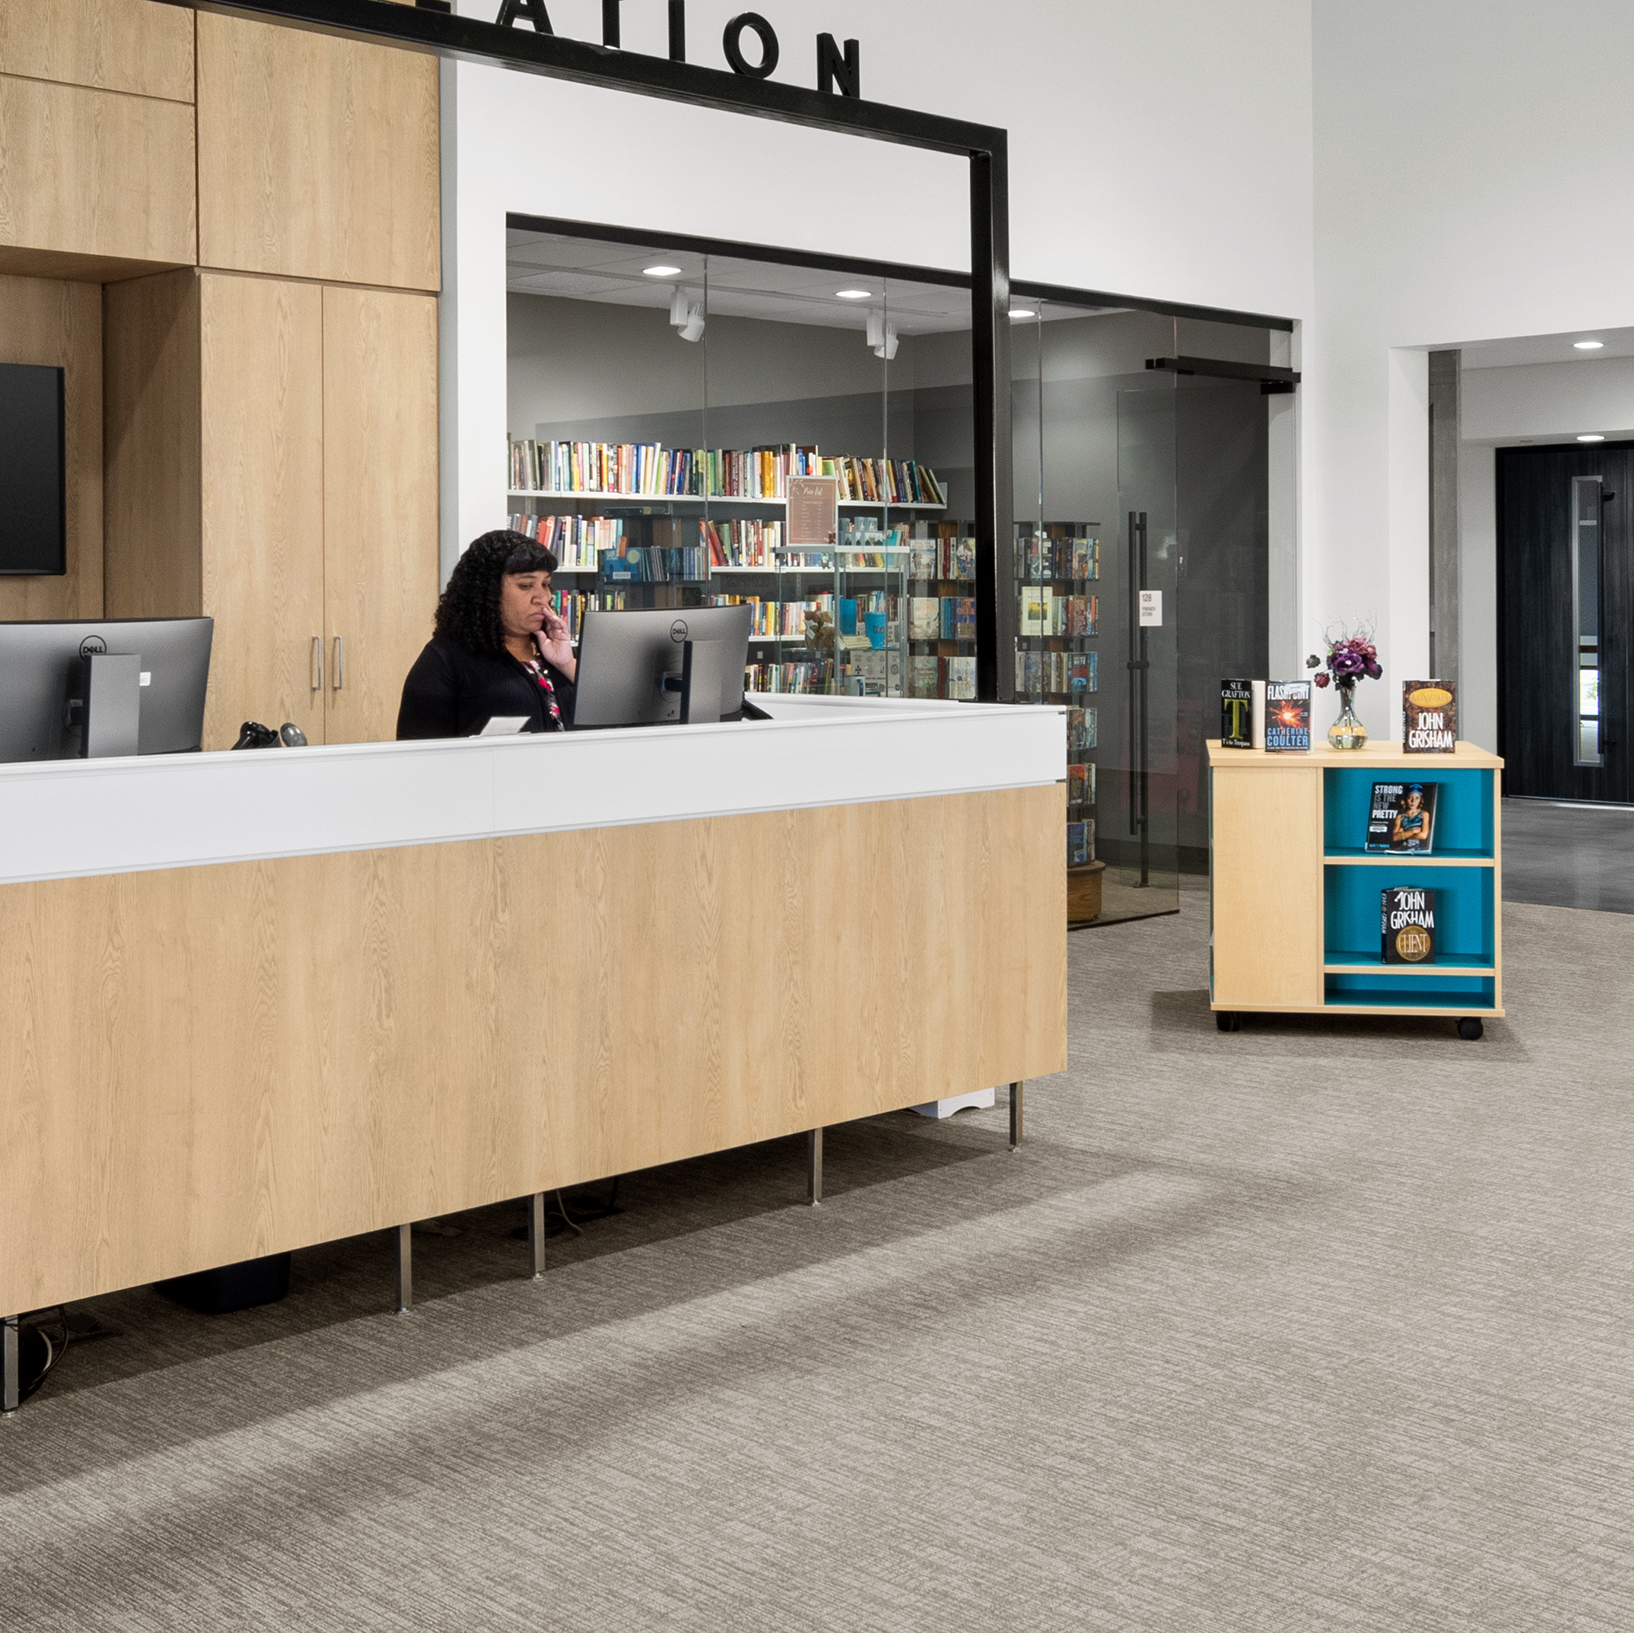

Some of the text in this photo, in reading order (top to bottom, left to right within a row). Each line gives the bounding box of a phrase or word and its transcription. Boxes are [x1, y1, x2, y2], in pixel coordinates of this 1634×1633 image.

[1142, 593, 1152, 602] 128
[83, 646, 103, 654] DELL
[1230, 682, 1242, 690] SUE
[1221, 689, 1250, 698] GRAFTON
[1224, 698, 1248, 739] T
[1417, 712, 1443, 730] JOHN
[1267, 736, 1308, 746] COULTER
[1409, 730, 1453, 748] GRISHAM
[1374, 785, 1403, 794] STRONG
[1383, 794, 1396, 802] THE
[1373, 802, 1389, 810] NEW
[1372, 809, 1398, 819] PRETTY
[1394, 891, 1425, 910] JOHN
[1390, 911, 1434, 929] GRISHAM
[1399, 934, 1427, 953] CLIENT
